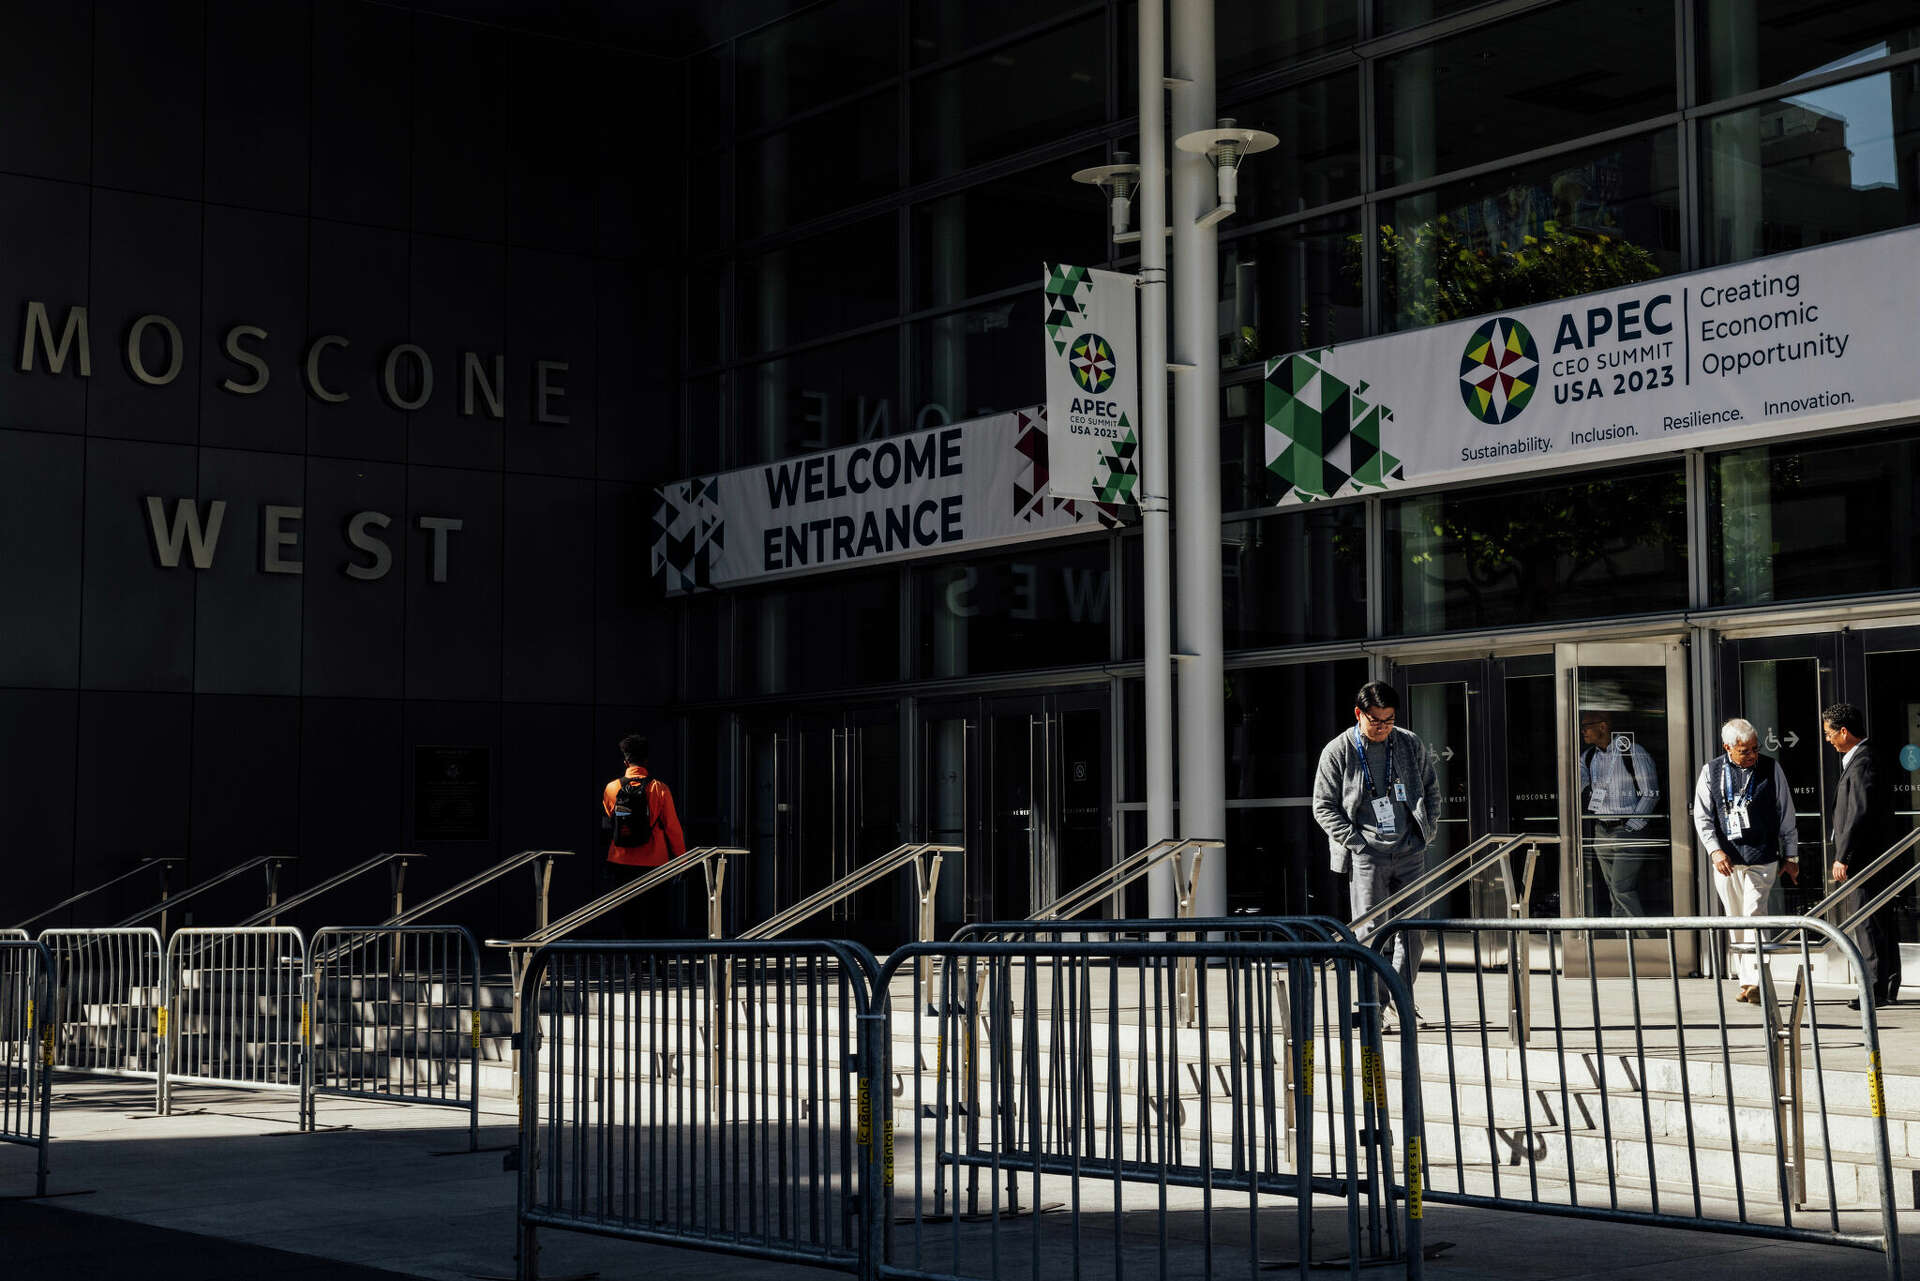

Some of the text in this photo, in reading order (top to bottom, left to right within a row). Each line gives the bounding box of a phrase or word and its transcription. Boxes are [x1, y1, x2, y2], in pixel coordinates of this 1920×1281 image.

[1700, 271, 1801, 309] Creating
[1553, 294, 1673, 354] APEC
[1701, 302, 1819, 342] Economic
[17, 301, 570, 425] MOSCONE
[1553, 341, 1674, 378] CEO SUMMIT
[1701, 332, 1850, 378] Opportunity
[1553, 365, 1675, 405] USA 2023
[1070, 398, 1118, 418] APEC
[1071, 415, 1118, 427] CEO SUMMIT
[1461, 389, 1855, 463] Sustainability. Inclusion. Resilience. Innovation.
[1071, 425, 1117, 438] USA 2023
[765, 428, 963, 510] WELCOME
[145, 496, 464, 584] WEST
[764, 494, 964, 572] ENTRANCE
[1516, 793, 1548, 801] MOSCONE
[1793, 787, 1816, 795] WEST
[884, 1122, 893, 1169] rentals
